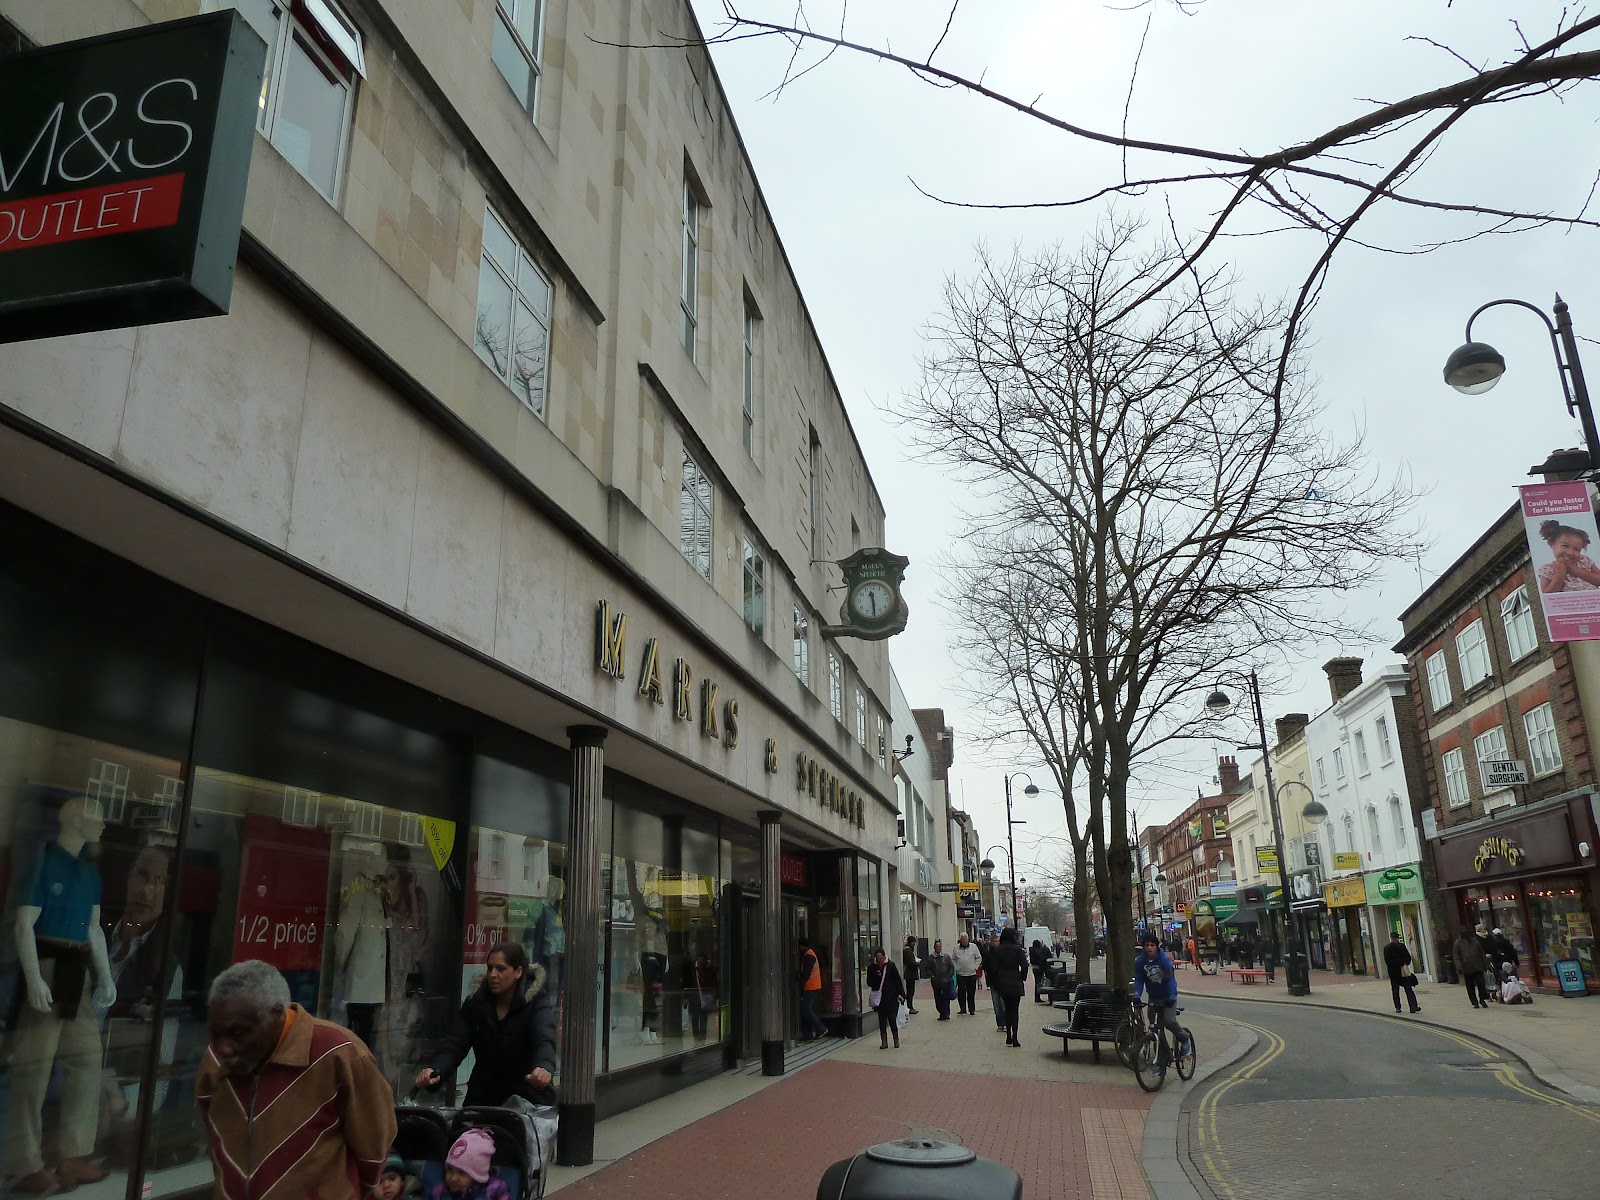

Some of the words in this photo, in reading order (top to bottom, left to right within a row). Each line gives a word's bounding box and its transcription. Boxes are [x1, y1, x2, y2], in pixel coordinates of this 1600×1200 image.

[1527, 499, 1548, 507] Could
[1548, 498, 1562, 507] you
[1545, 503, 1583, 513] Hounslow?
[861, 562, 884, 570] MARKS
[598, 598, 740, 750] MARKS
[1492, 762, 1519, 773] DENTAL
[1489, 773, 1525, 784] SURGEONS
[239, 914, 270, 943] 1/2
[273, 917, 317, 950] price
[464, 923, 486, 946] 0%
